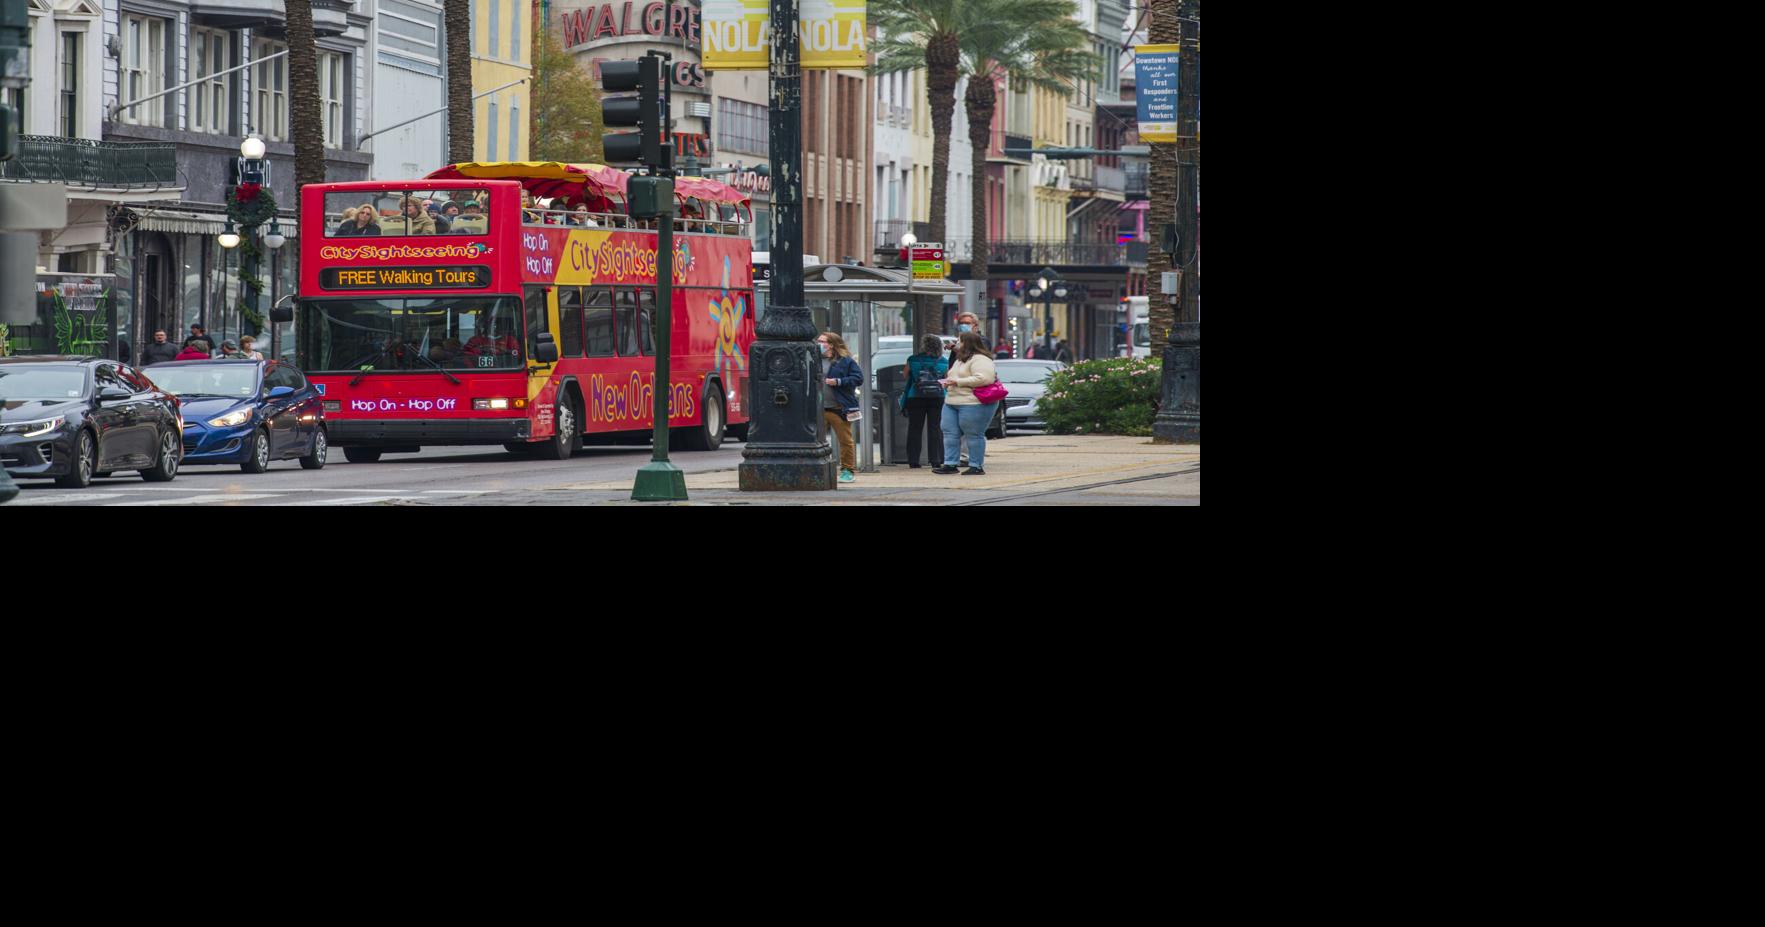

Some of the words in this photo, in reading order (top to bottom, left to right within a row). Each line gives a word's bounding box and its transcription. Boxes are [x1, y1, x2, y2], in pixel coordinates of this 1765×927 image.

[703, 20, 768, 52] NOLA
[800, 20, 865, 51] NOLA
[1152, 79, 1168, 87] First
[1148, 103, 1174, 111] Frontline
[523, 233, 537, 251] Hop
[538, 233, 548, 250] On
[320, 245, 480, 260] CitySightseeing
[571, 239, 687, 283] CitySightseg
[526, 256, 540, 275] Hop
[541, 256, 553, 274] Off
[338, 271, 376, 285] FREE
[379, 270, 433, 285] Walking
[435, 269, 476, 283] Tours
[478, 356, 494, 367] 66
[351, 399, 376, 411] Hop
[379, 399, 397, 410] On
[408, 399, 433, 410] Hop
[436, 398, 456, 409] Off
[591, 373, 627, 422] New
[629, 370, 694, 420] Orlans
